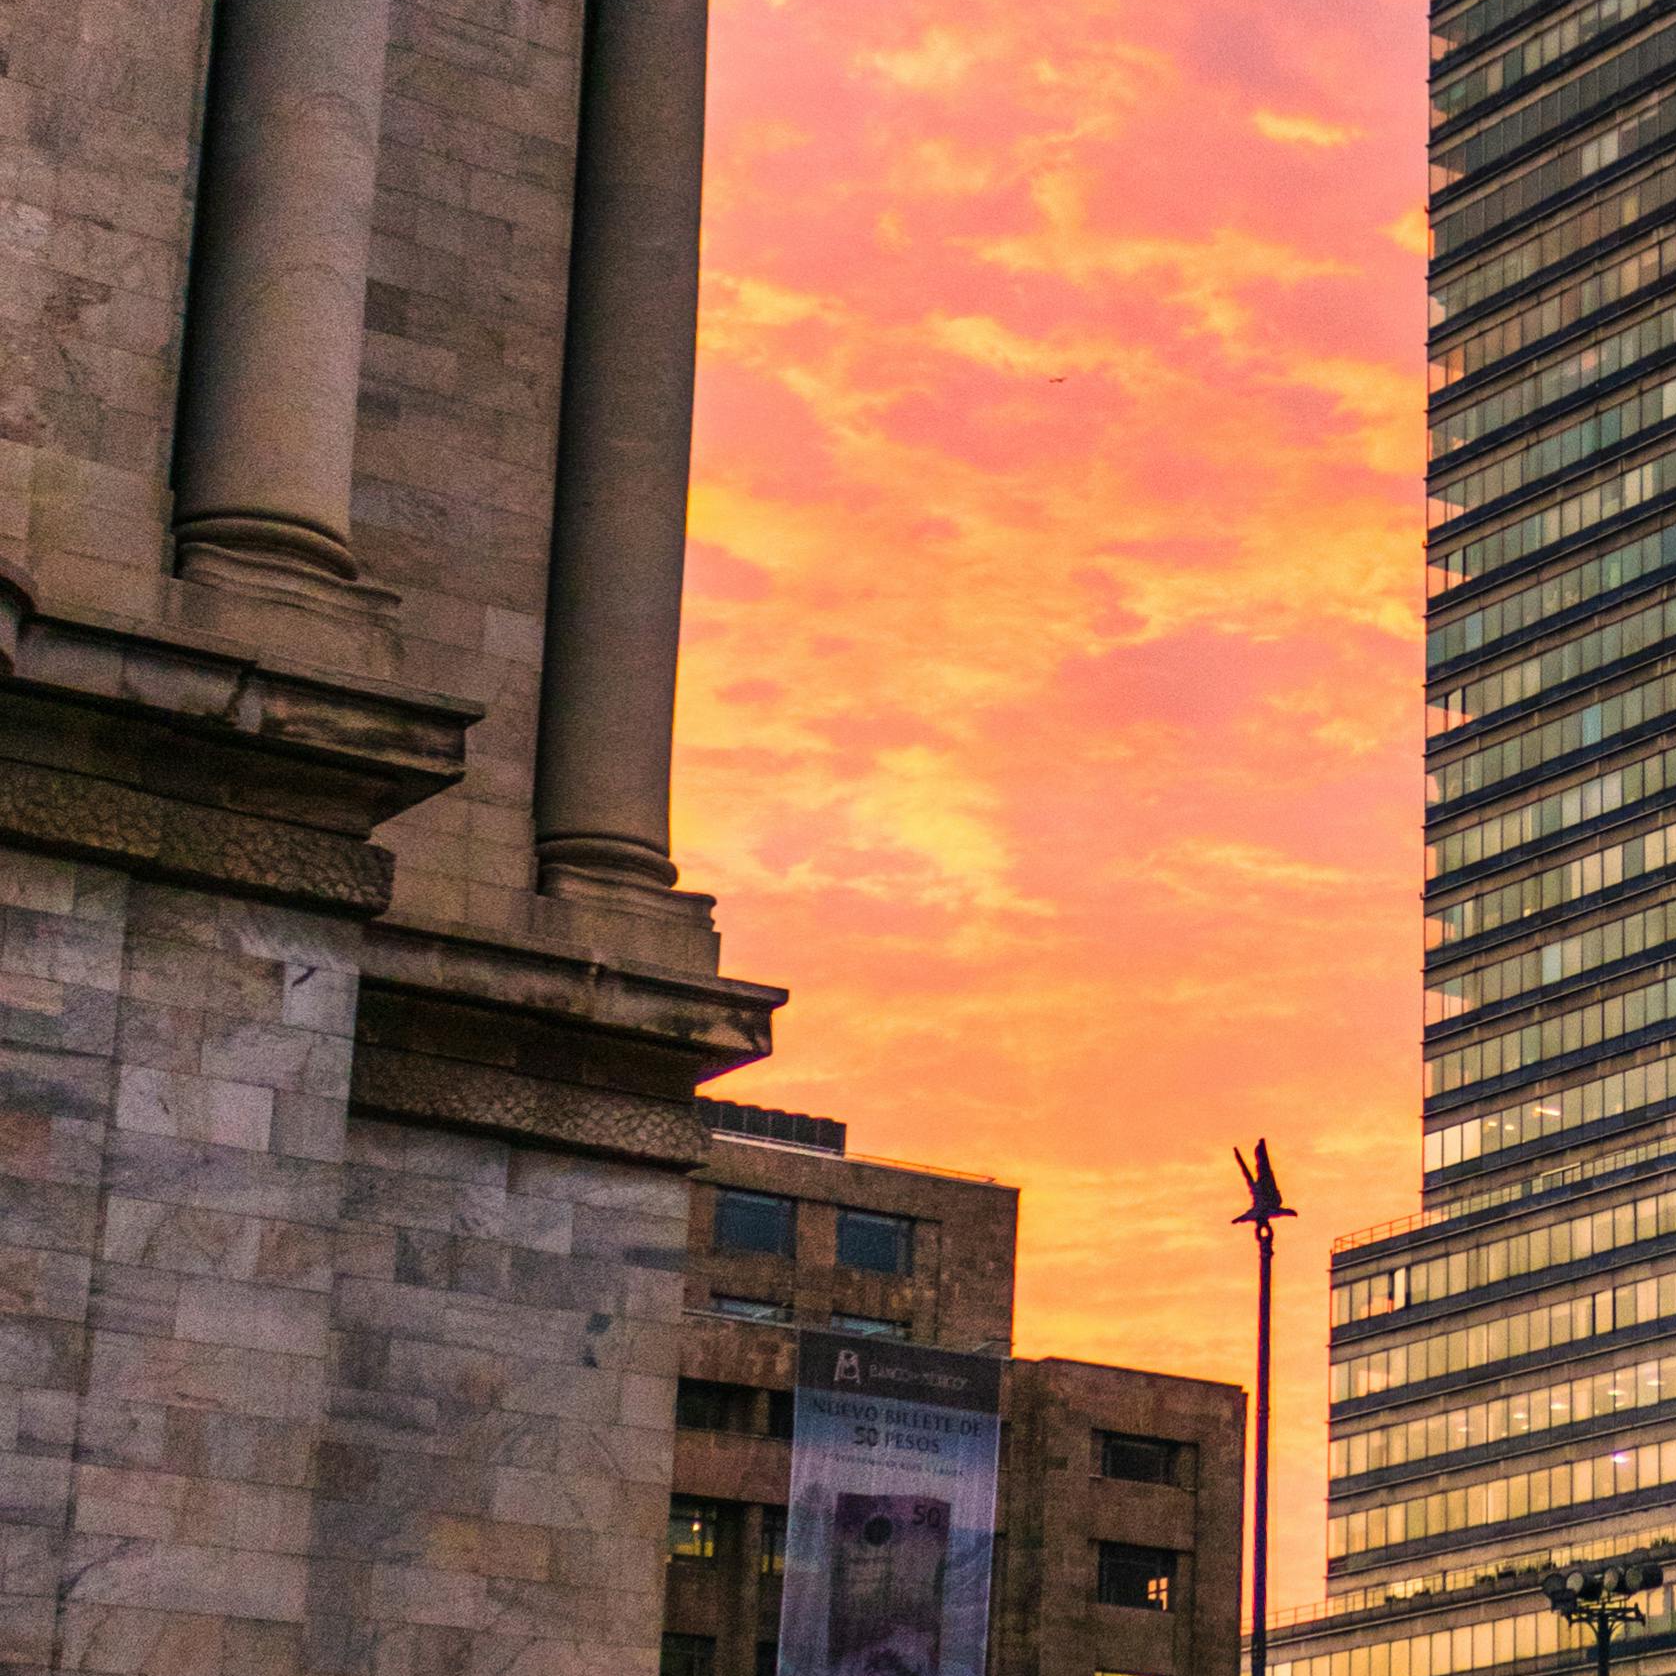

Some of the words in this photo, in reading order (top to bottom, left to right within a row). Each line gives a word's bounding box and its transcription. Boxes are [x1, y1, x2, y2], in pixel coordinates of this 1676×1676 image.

[813, 1397, 879, 1420] NUEVO
[885, 1408, 952, 1434] BILLETE
[960, 1419, 982, 1437] DE
[853, 1425, 879, 1449] 50
[885, 1432, 941, 1454] PESOS
[911, 1503, 941, 1528] 50
